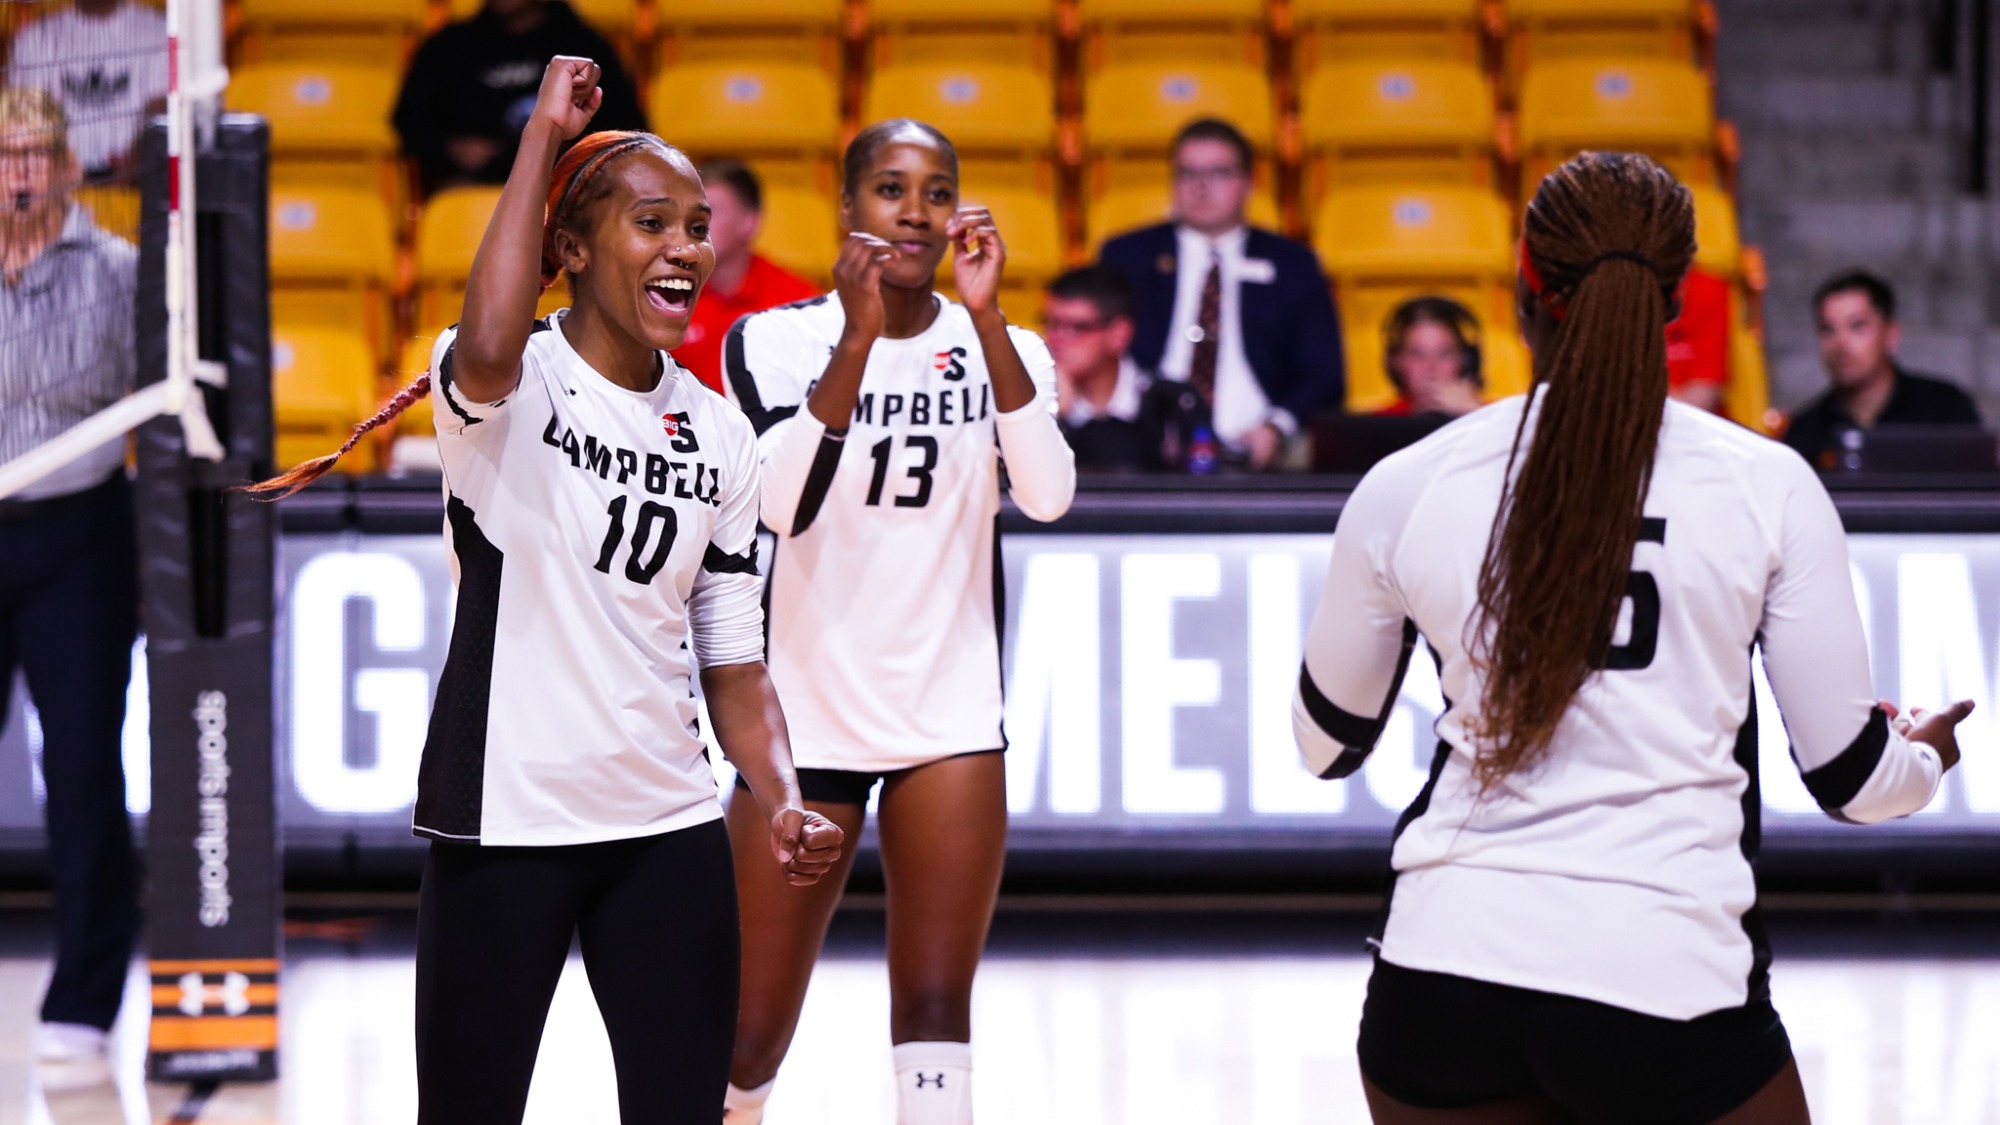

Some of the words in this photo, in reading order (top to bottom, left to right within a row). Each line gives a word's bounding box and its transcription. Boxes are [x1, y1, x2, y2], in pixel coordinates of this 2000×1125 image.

[865, 435, 938, 507] 13
[593, 494, 678, 585] 10
[191, 690, 232, 797] sports
[193, 798, 233, 927] imports
